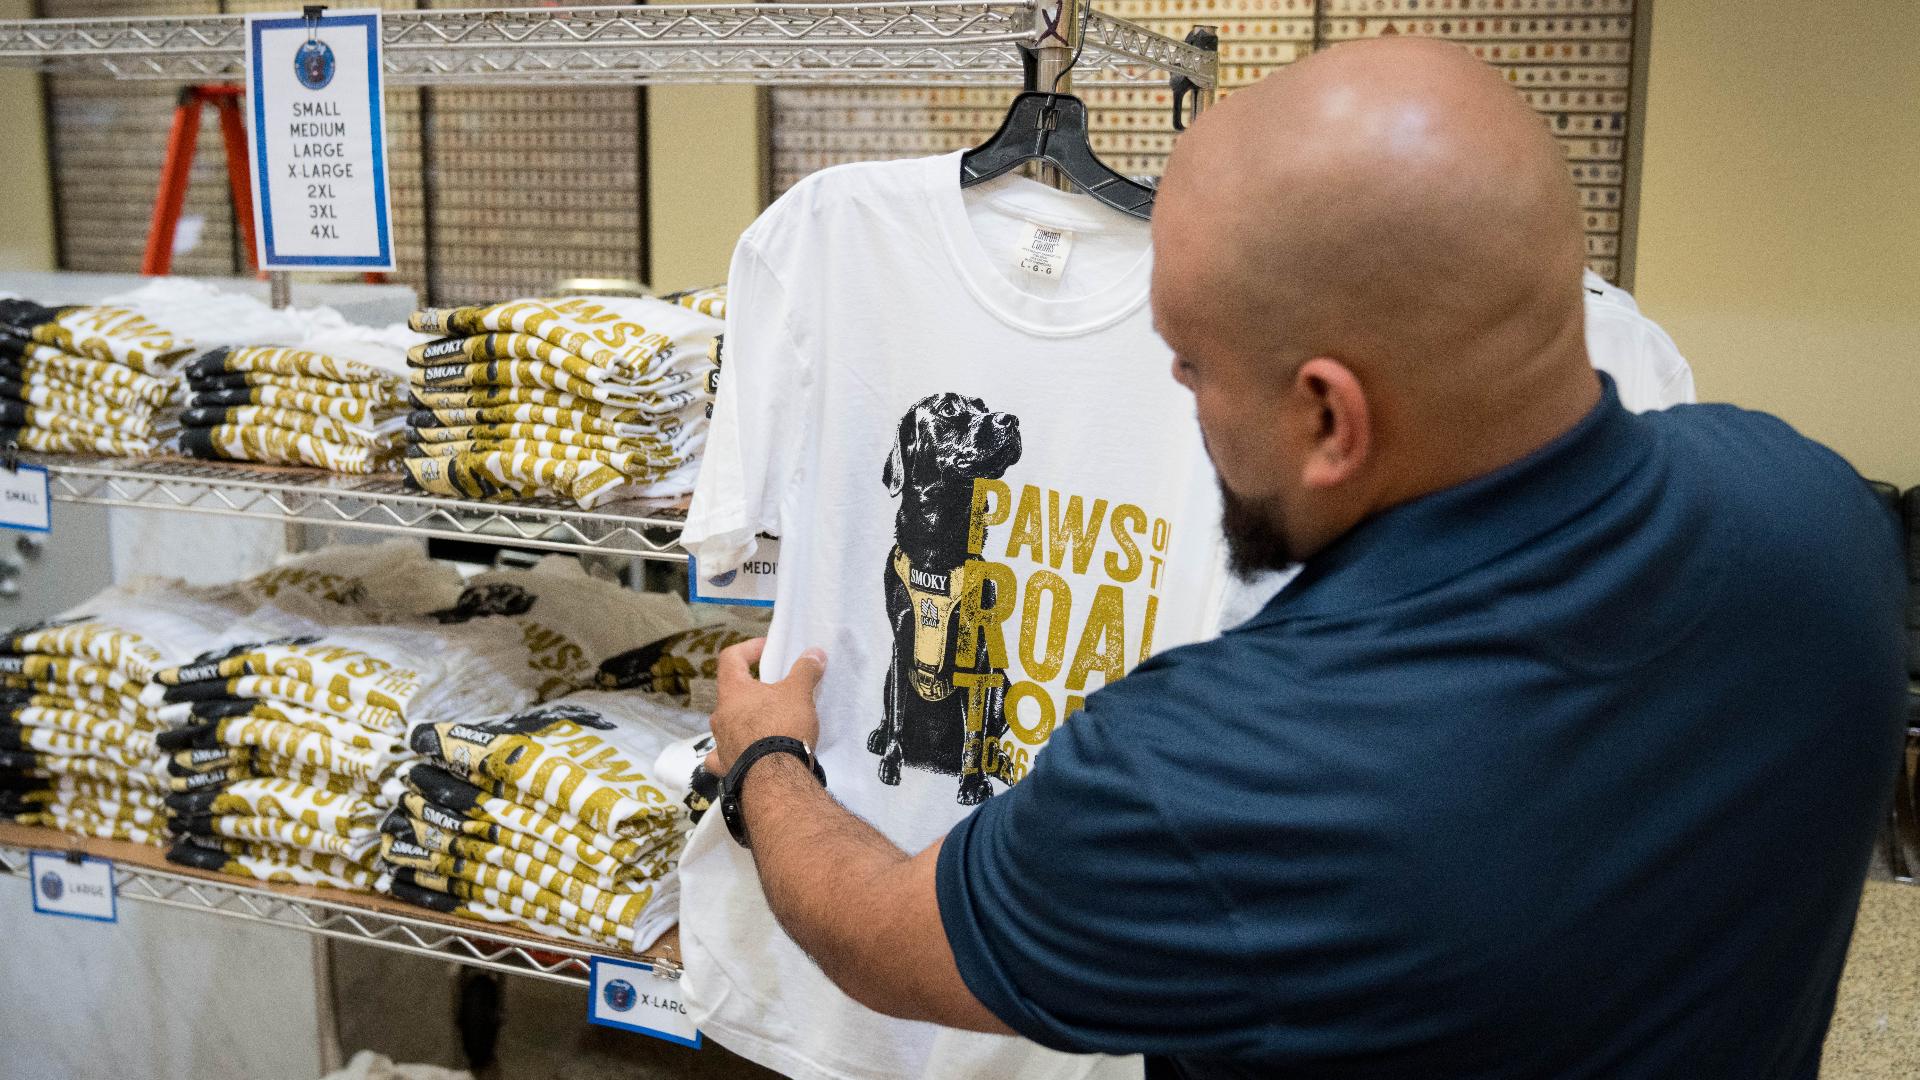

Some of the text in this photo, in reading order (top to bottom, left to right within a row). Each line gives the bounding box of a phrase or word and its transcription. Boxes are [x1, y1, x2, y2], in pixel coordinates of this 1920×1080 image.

[292, 102, 341, 118] SMALL
[289, 122, 346, 138] MEDIUM
[293, 143, 345, 159] LARGE
[307, 184, 337, 199] 2XL
[309, 204, 338, 220] 3XL
[310, 224, 340, 240] 4XL
[968, 477, 1148, 583] PAWS
[1151, 517, 1172, 555] O
[742, 561, 779, 575] MEDI
[910, 568, 948, 591] SMOKY
[952, 671, 1086, 746] TO
[641, 993, 687, 1015] X-LARG
